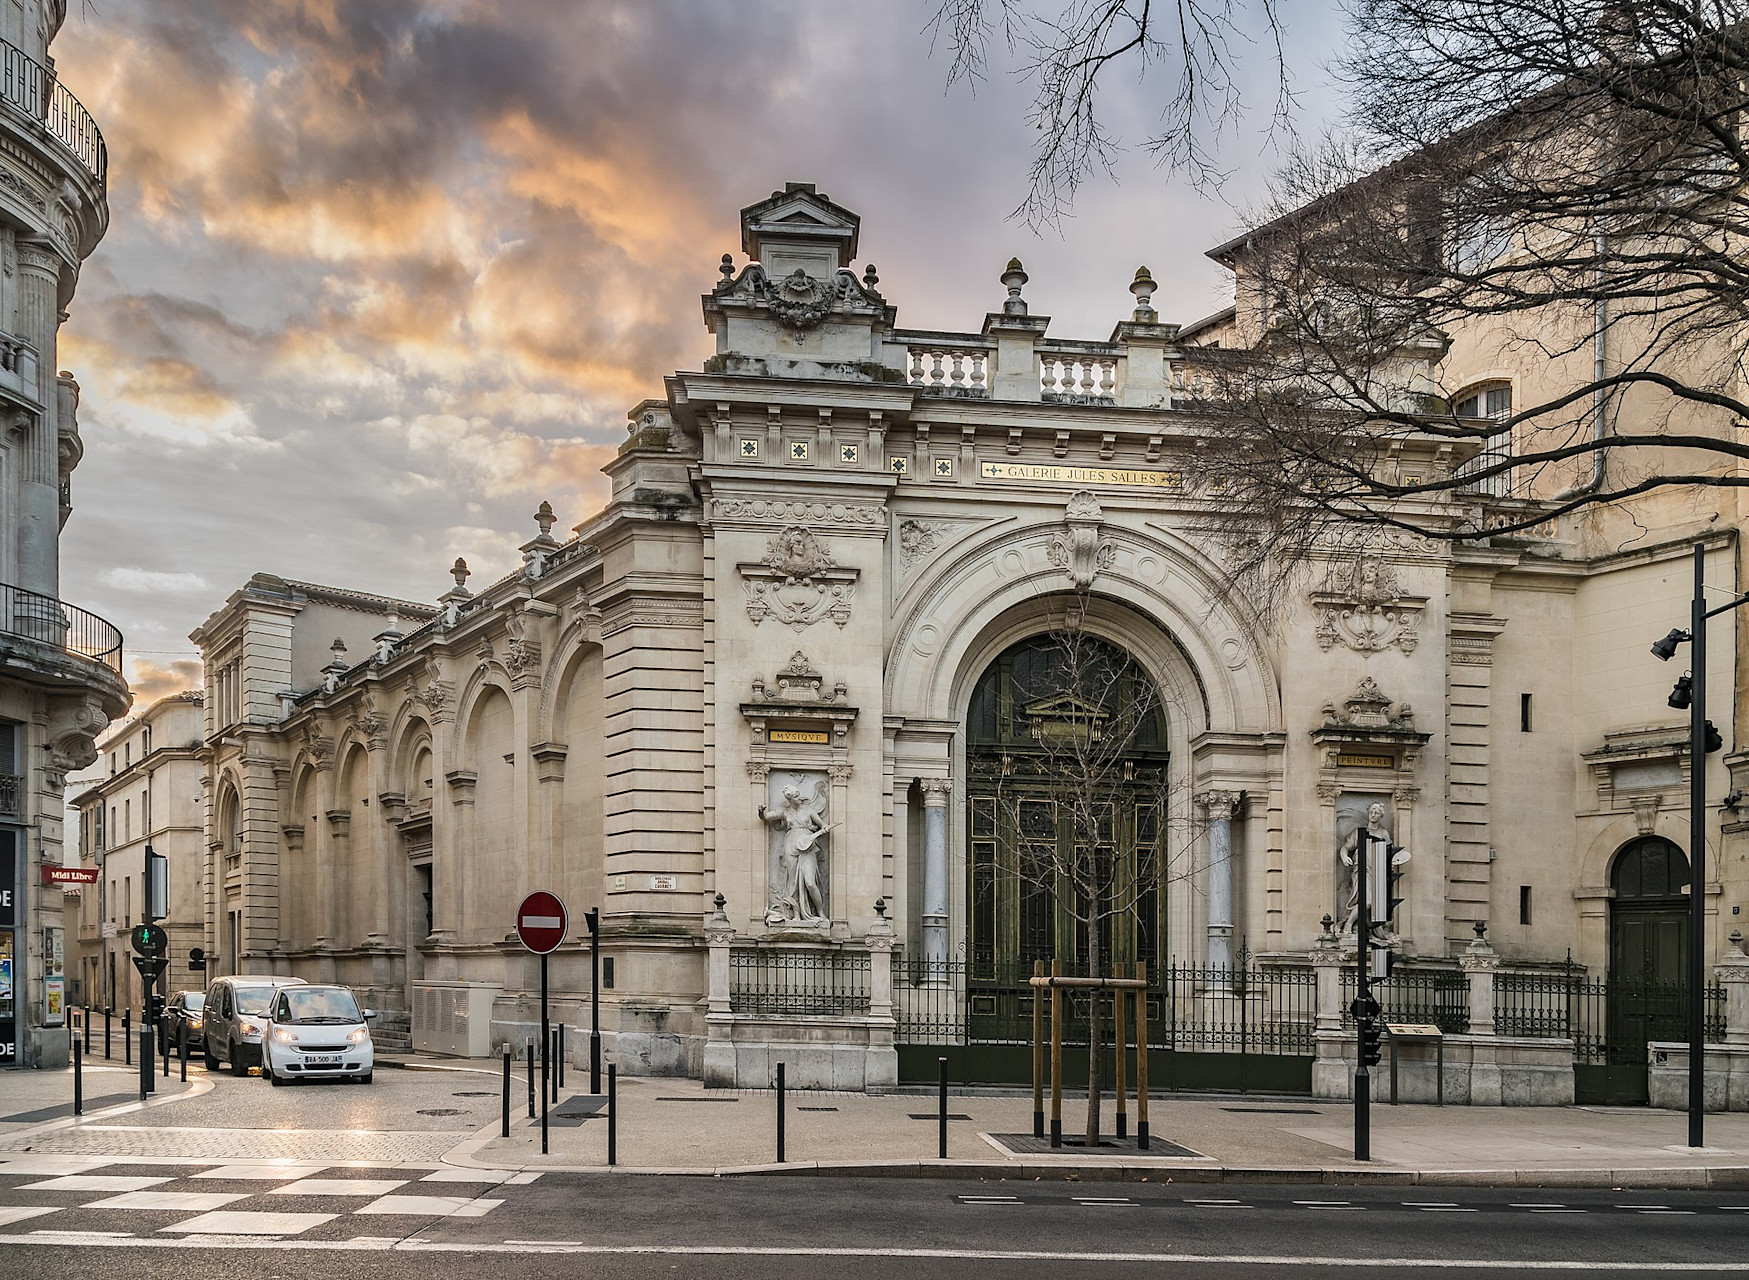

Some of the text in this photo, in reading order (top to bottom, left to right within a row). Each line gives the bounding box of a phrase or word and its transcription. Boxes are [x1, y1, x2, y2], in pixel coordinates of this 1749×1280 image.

[1008, 466, 1156, 484] GALERIE JULES SALLES
[51, 871, 93, 880] Midi Libre
